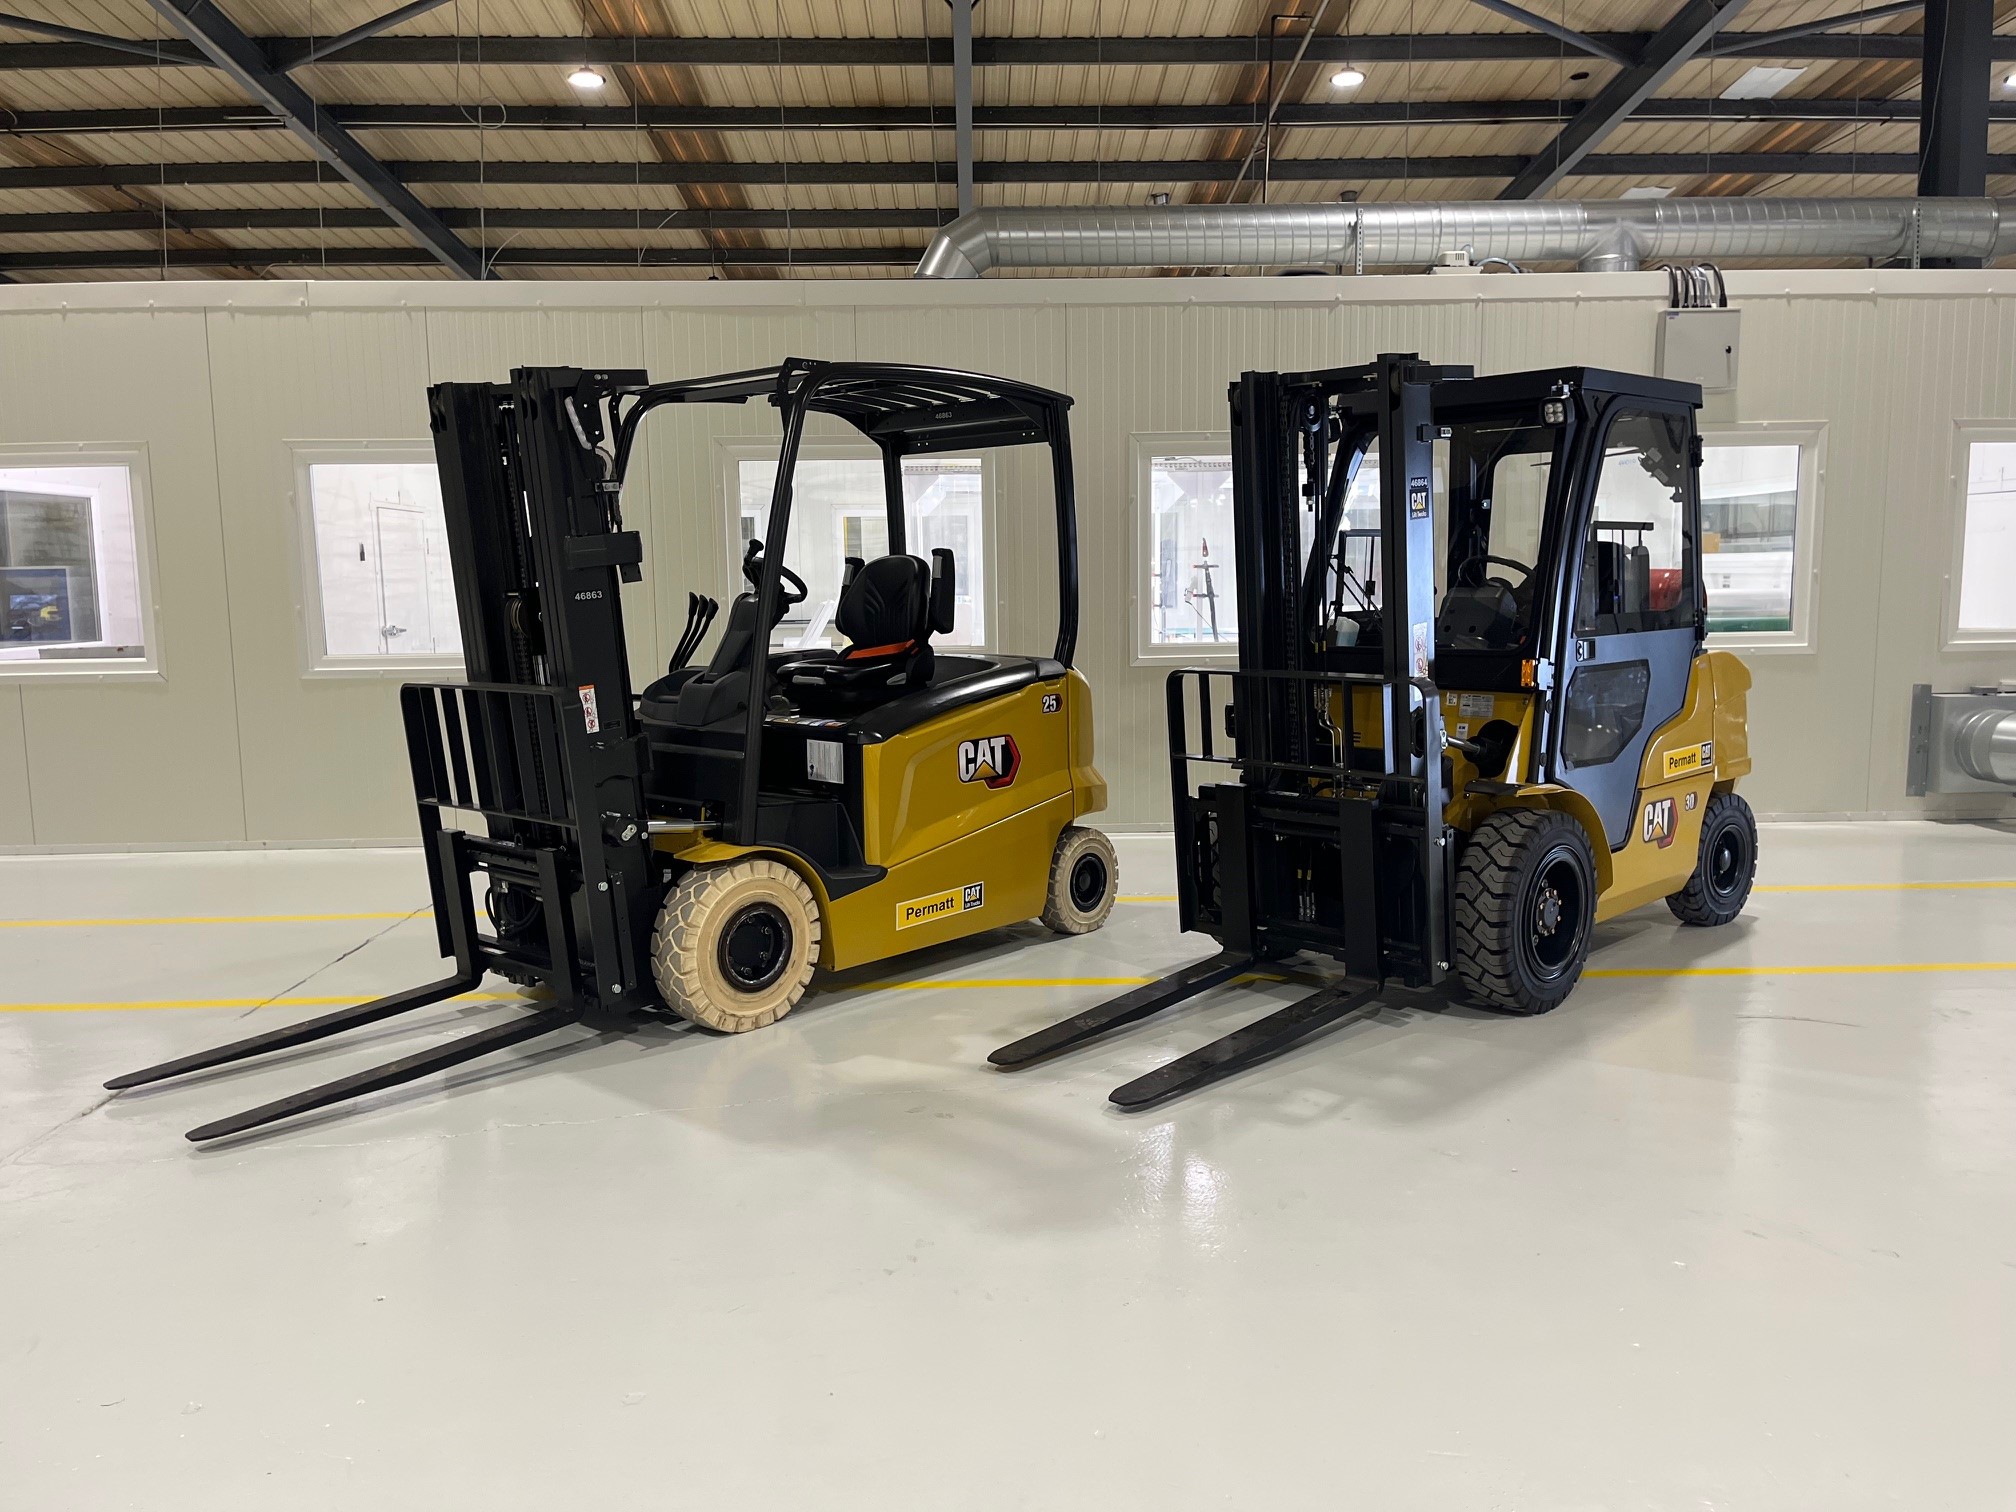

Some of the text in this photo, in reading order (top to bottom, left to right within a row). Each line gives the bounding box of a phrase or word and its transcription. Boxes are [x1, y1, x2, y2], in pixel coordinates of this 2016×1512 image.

[935, 411, 952, 419] 46863
[1411, 492, 1427, 510] CAT
[575, 591, 602, 600] 46863
[1042, 695, 1057, 712] 25
[959, 736, 1005, 781] CAT
[1669, 753, 1696, 769] Permatt
[1685, 793, 1695, 811] 30
[1644, 800, 1670, 841] CAT
[965, 886, 981, 902] CAT
[906, 897, 954, 920] Permatt
